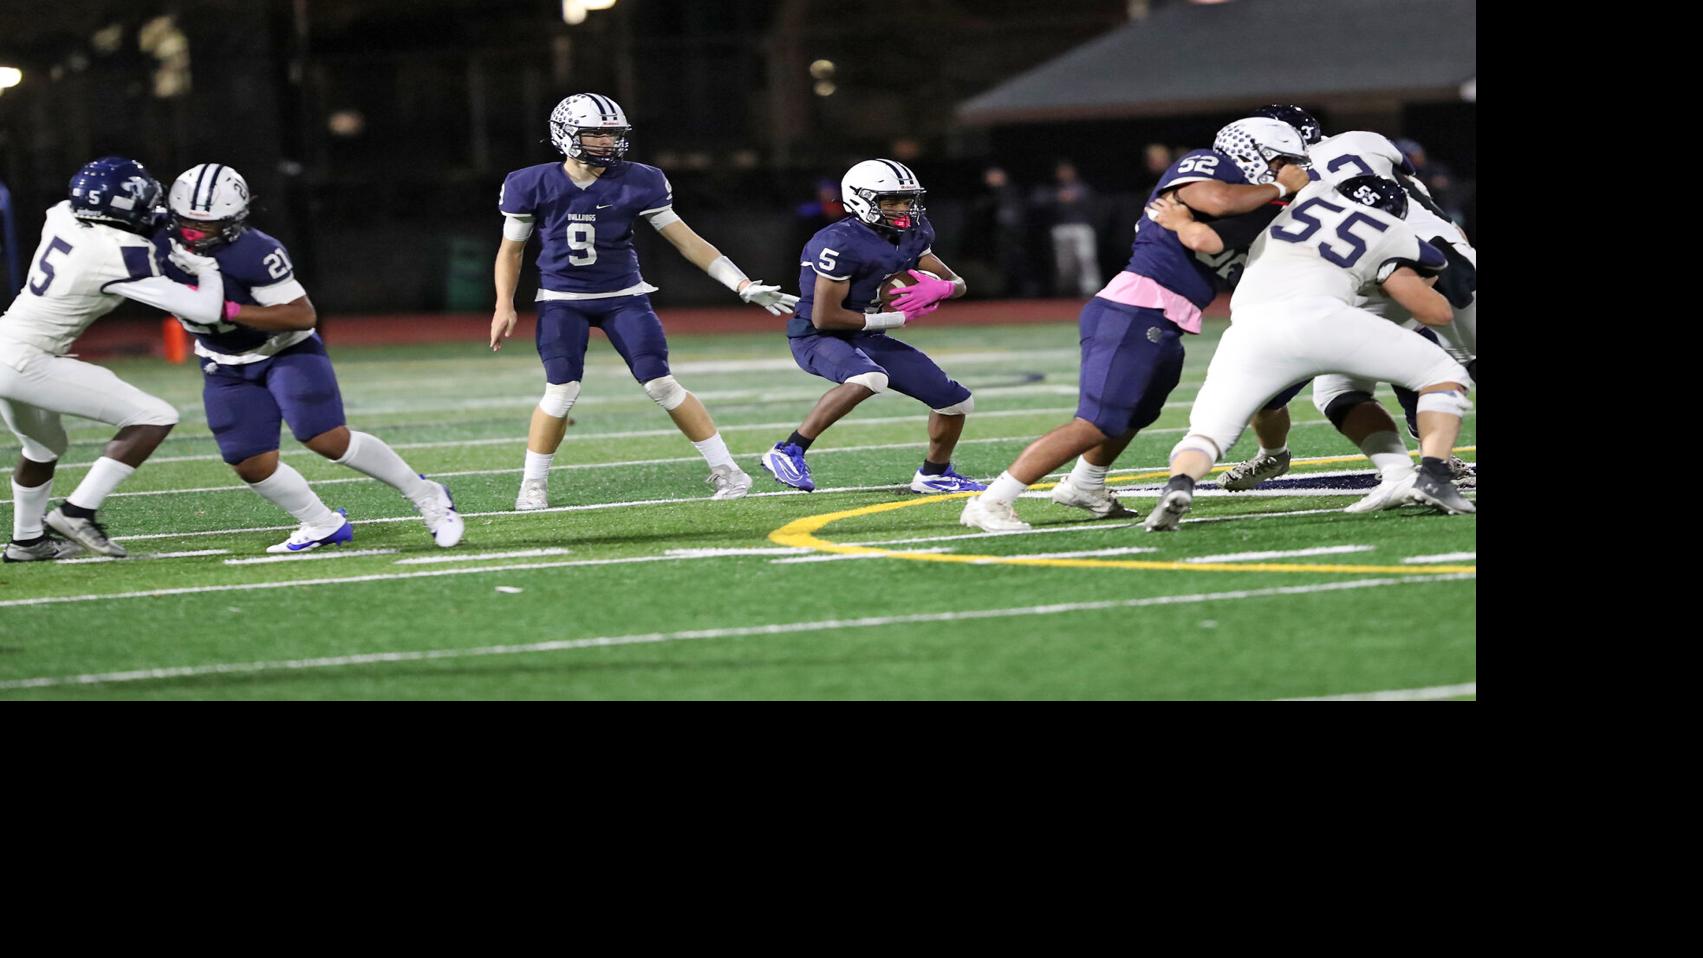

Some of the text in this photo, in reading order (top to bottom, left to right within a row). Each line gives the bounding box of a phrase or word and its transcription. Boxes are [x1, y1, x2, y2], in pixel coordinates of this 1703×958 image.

[1177, 155, 1219, 175] 52
[88, 190, 100, 205] 5
[1353, 185, 1381, 205] 55
[567, 222, 597, 266] 9
[1270, 196, 1390, 269] 55
[29, 235, 74, 297] 5
[263, 247, 293, 280] 21
[819, 248, 839, 271] 5
